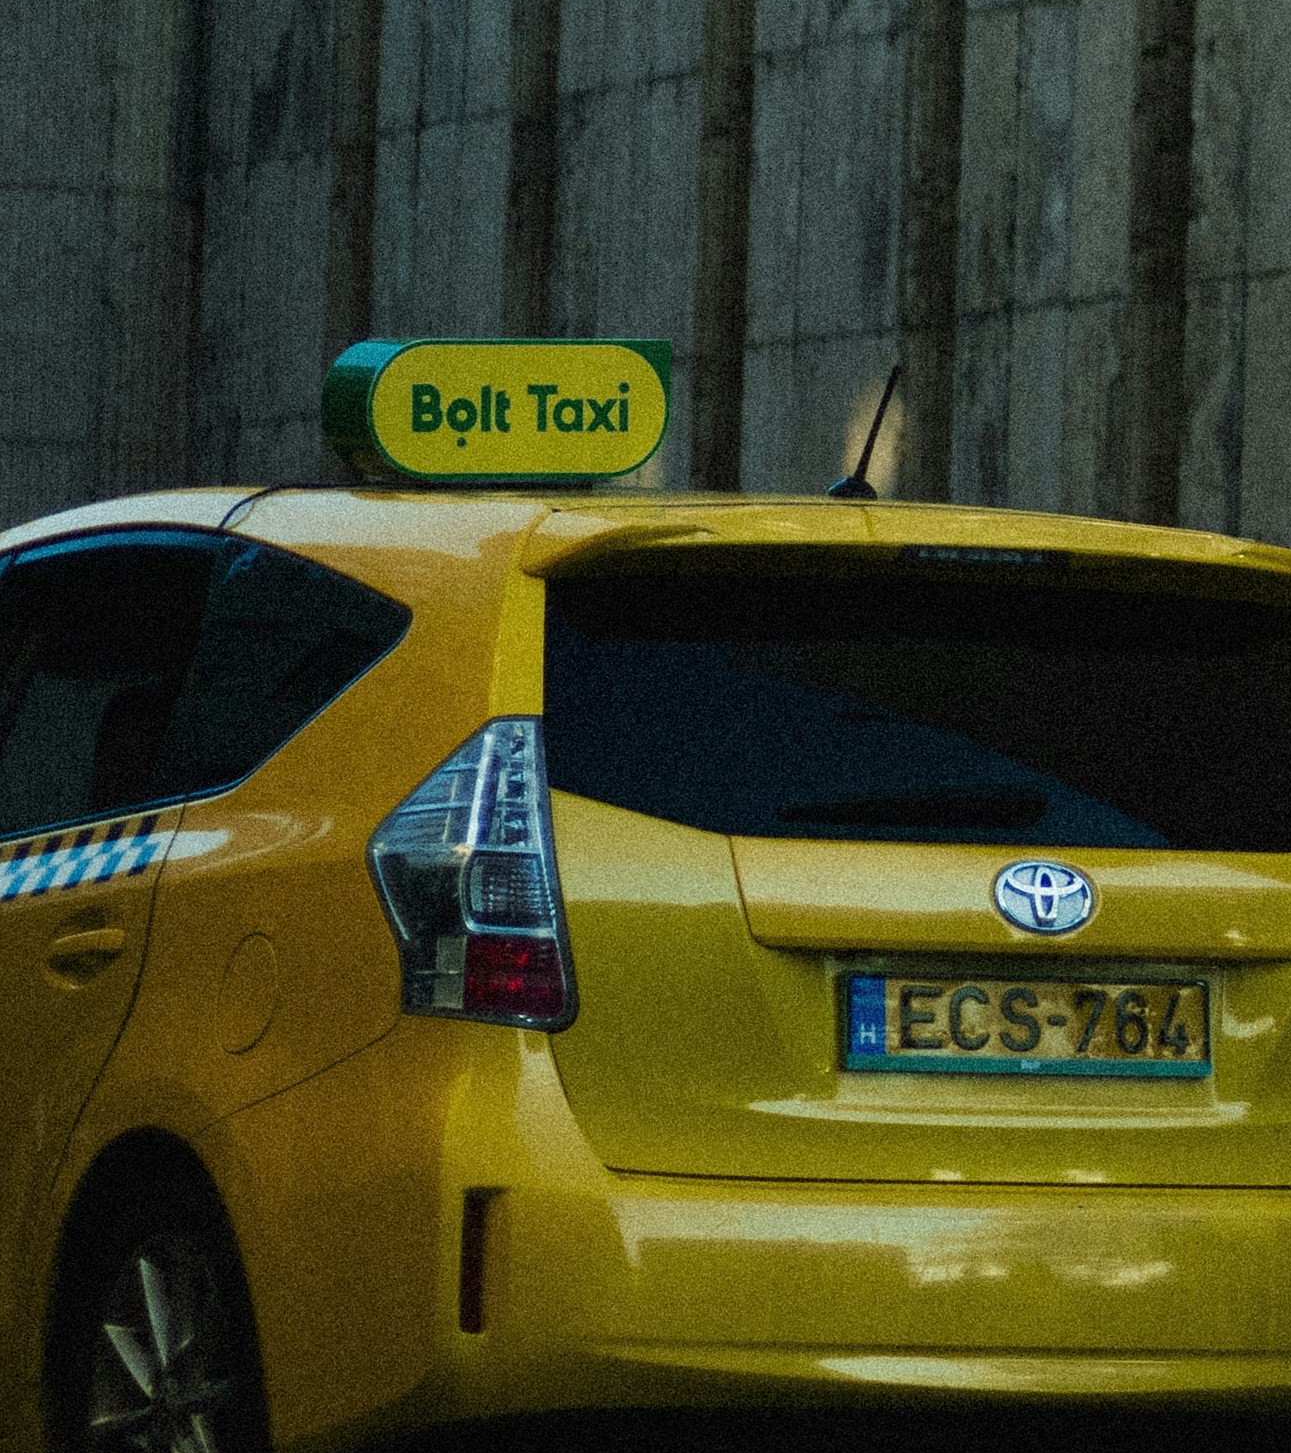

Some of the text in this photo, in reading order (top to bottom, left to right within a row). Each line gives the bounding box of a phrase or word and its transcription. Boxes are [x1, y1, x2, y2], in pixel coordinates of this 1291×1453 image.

[411, 382, 631, 448] Bolt Taxi
[859, 983, 1191, 1056] H ECS-764
